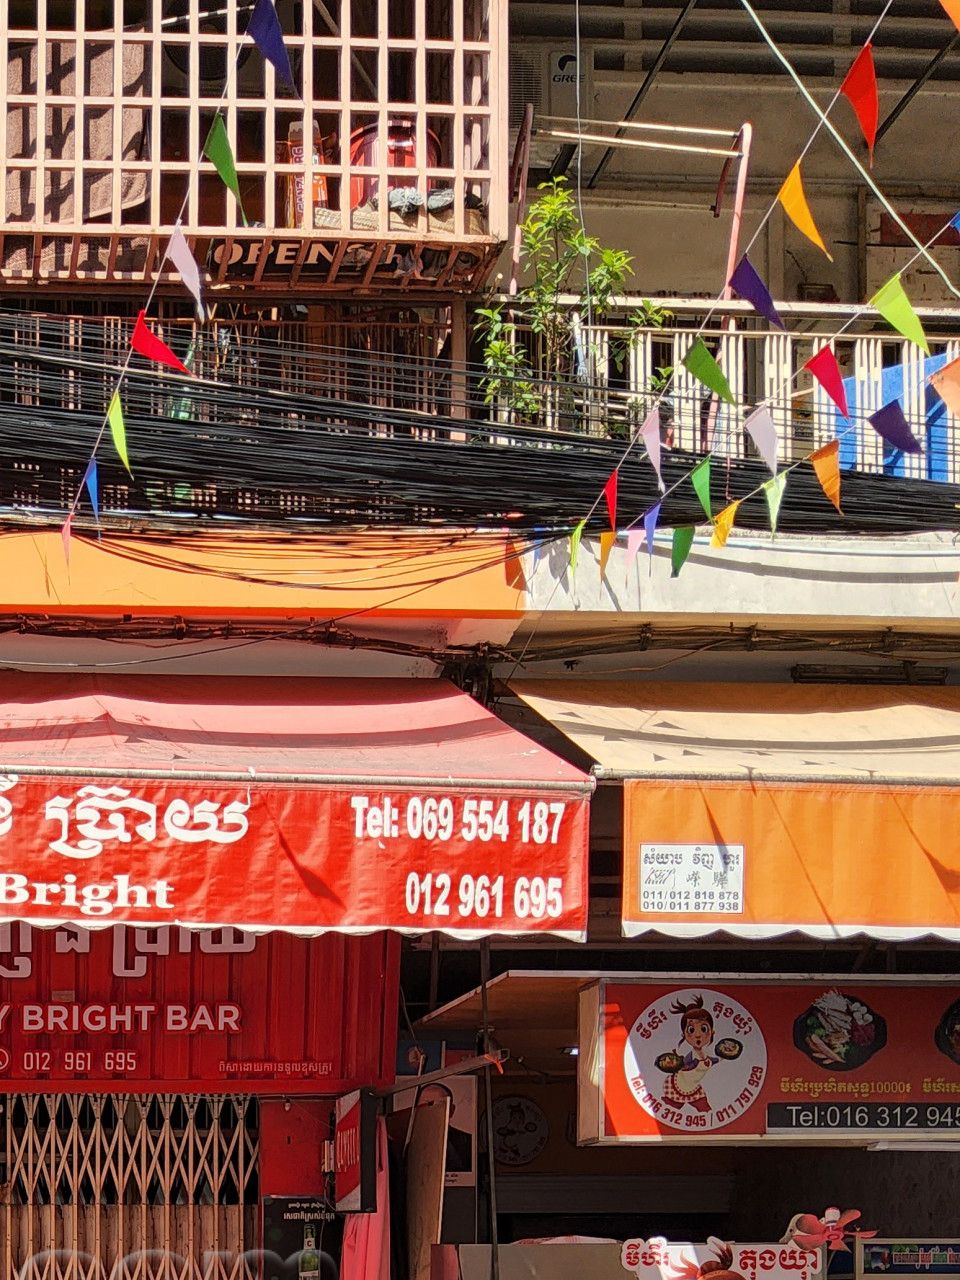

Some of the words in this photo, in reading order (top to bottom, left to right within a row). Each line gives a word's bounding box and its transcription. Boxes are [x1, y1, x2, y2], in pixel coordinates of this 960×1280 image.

[213, 243, 340, 265] OPEN
[351, 796, 399, 838] Tel:
[406, 797, 454, 841] 069
[461, 800, 510, 842] 554
[518, 801, 566, 844] 187
[405, 872, 451, 916] 012
[458, 874, 504, 917] 961
[514, 876, 563, 918] 695
[643, 891, 690, 900] 011/012
[694, 891, 715, 900] 818
[718, 891, 739, 900] 878
[643, 901, 690, 910] 010/011
[694, 901, 715, 910] 877
[718, 902, 739, 911] 938
[23, 1004, 155, 1031] BRIGHT
[166, 1004, 241, 1031] BAR
[23, 1052, 51, 1071] 012
[64, 1052, 92, 1071] 961
[105, 1052, 137, 1071] 695
[642, 1093, 662, 1114] 016
[661, 1108, 683, 1125] 312
[685, 1115, 707, 1127] 945
[716, 1104, 738, 1123] 011
[734, 1088, 754, 1107] 797
[748, 1065, 764, 1088] 929
[786, 1106, 869, 1127] Tel:016
[876, 1106, 919, 1127] 312
